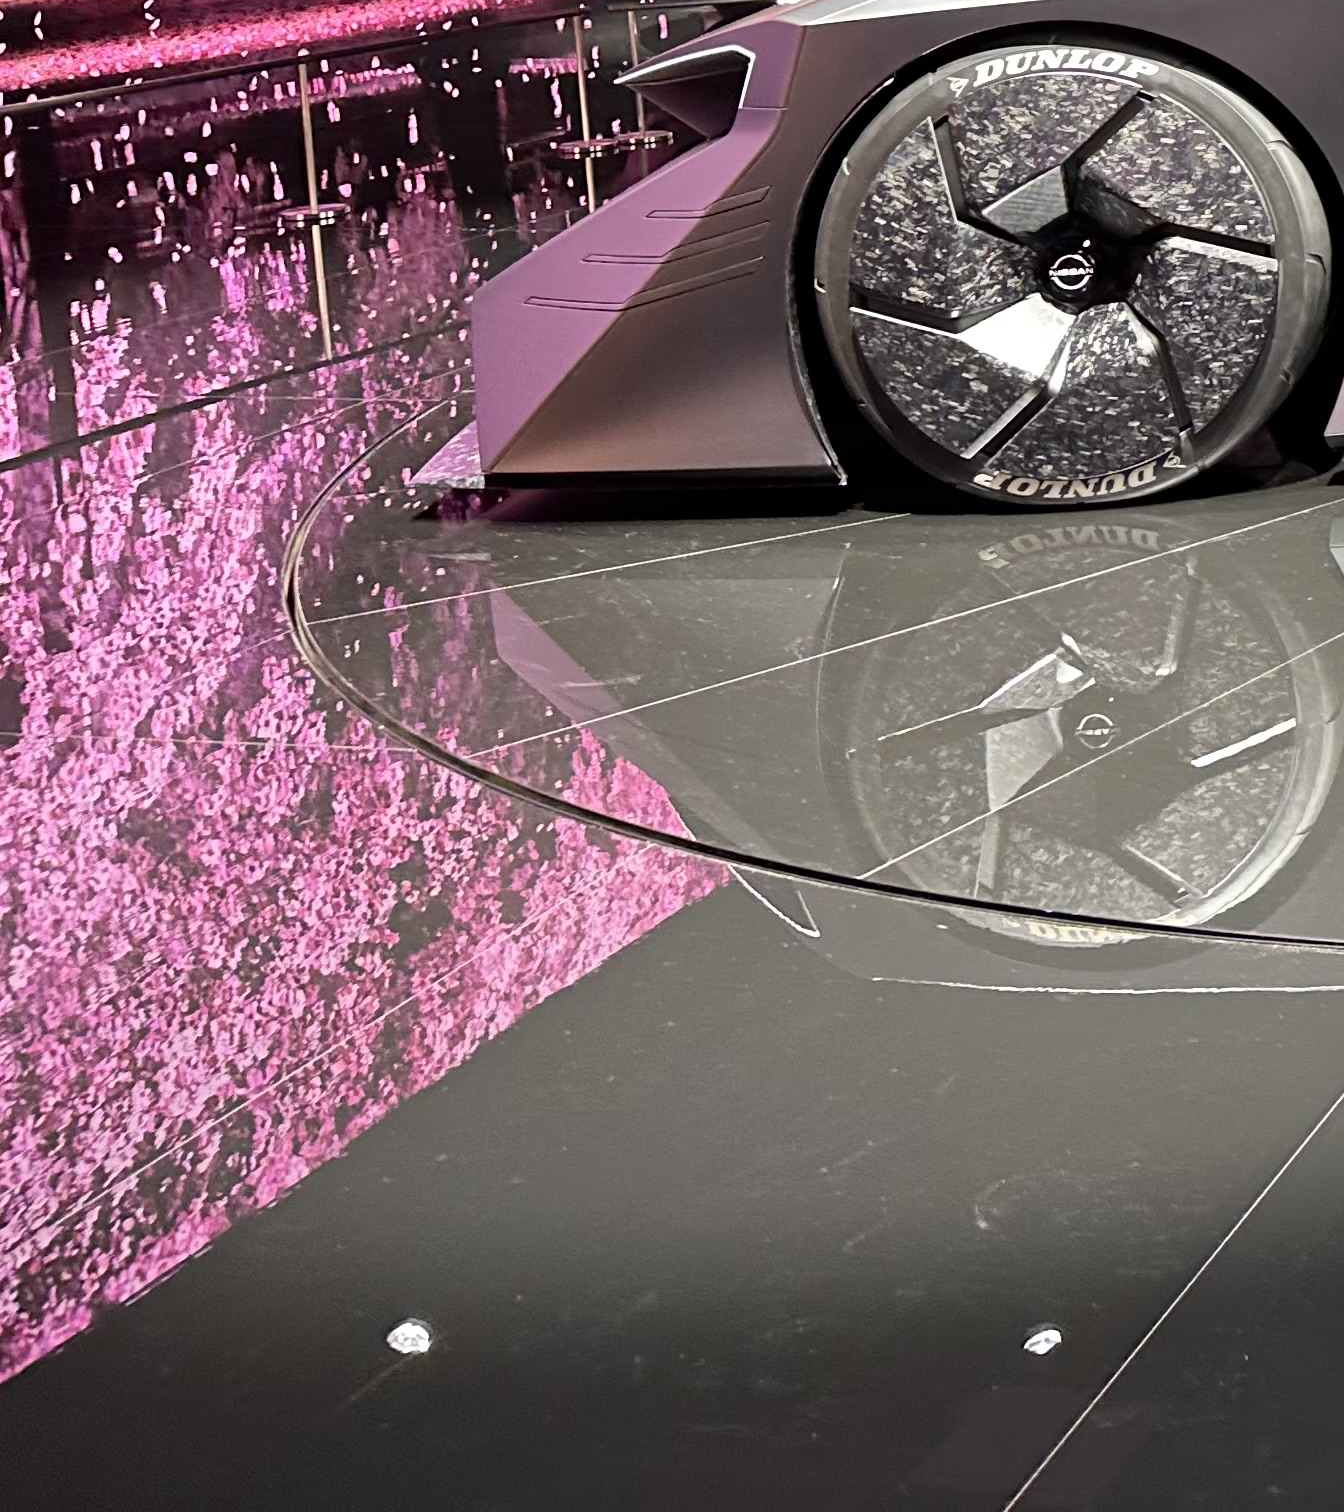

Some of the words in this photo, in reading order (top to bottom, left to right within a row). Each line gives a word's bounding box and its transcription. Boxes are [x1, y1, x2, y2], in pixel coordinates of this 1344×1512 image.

[973, 48, 1160, 88] DUNLOP
[1048, 267, 1094, 277] NISSAN
[974, 464, 1158, 500] DUNLOP
